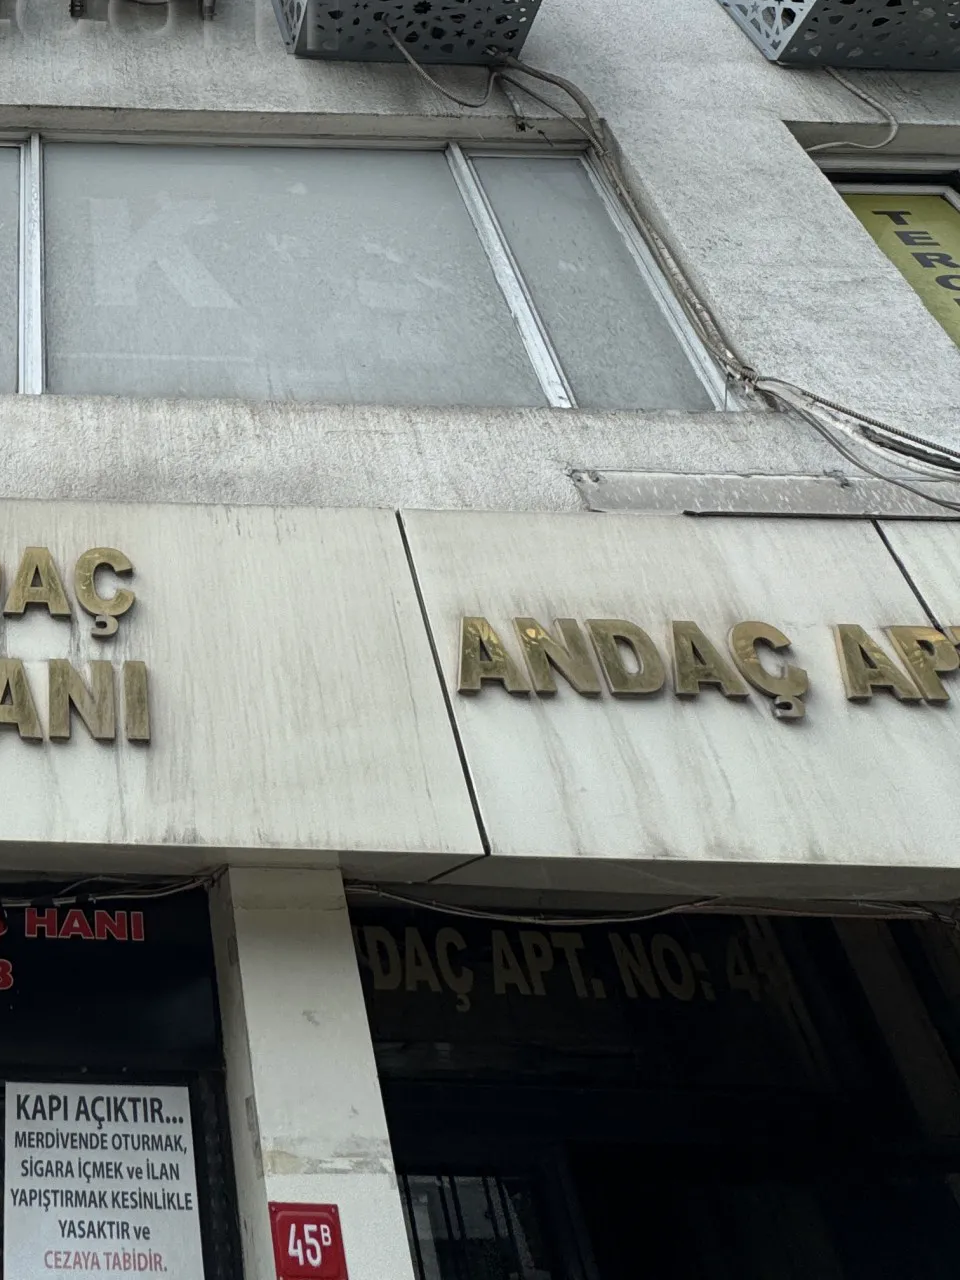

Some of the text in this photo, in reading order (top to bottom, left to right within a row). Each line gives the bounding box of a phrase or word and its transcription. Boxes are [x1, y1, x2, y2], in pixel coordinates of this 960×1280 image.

[457, 616, 960, 720] ANDAÇ AP
[25, 907, 145, 942] HANI
[362, 924, 474, 1013] DAÇ
[492, 928, 607, 1000] APT.
[608, 931, 717, 1003] NO:
[16, 1094, 184, 1130] KAPI AÇIKTIR...
[14, 1128, 187, 1155] MERDİVENDE OTURMAK,
[21, 1156, 180, 1183] SİGARA İÇMEK ve İLAN
[10, 1187, 193, 1212] YAPIŞTIRMAK KESİNLİKLE
[58, 1219, 151, 1240] YASAKTIR ve
[44, 1248, 168, 1272] CEZAYA TABİDİR.
